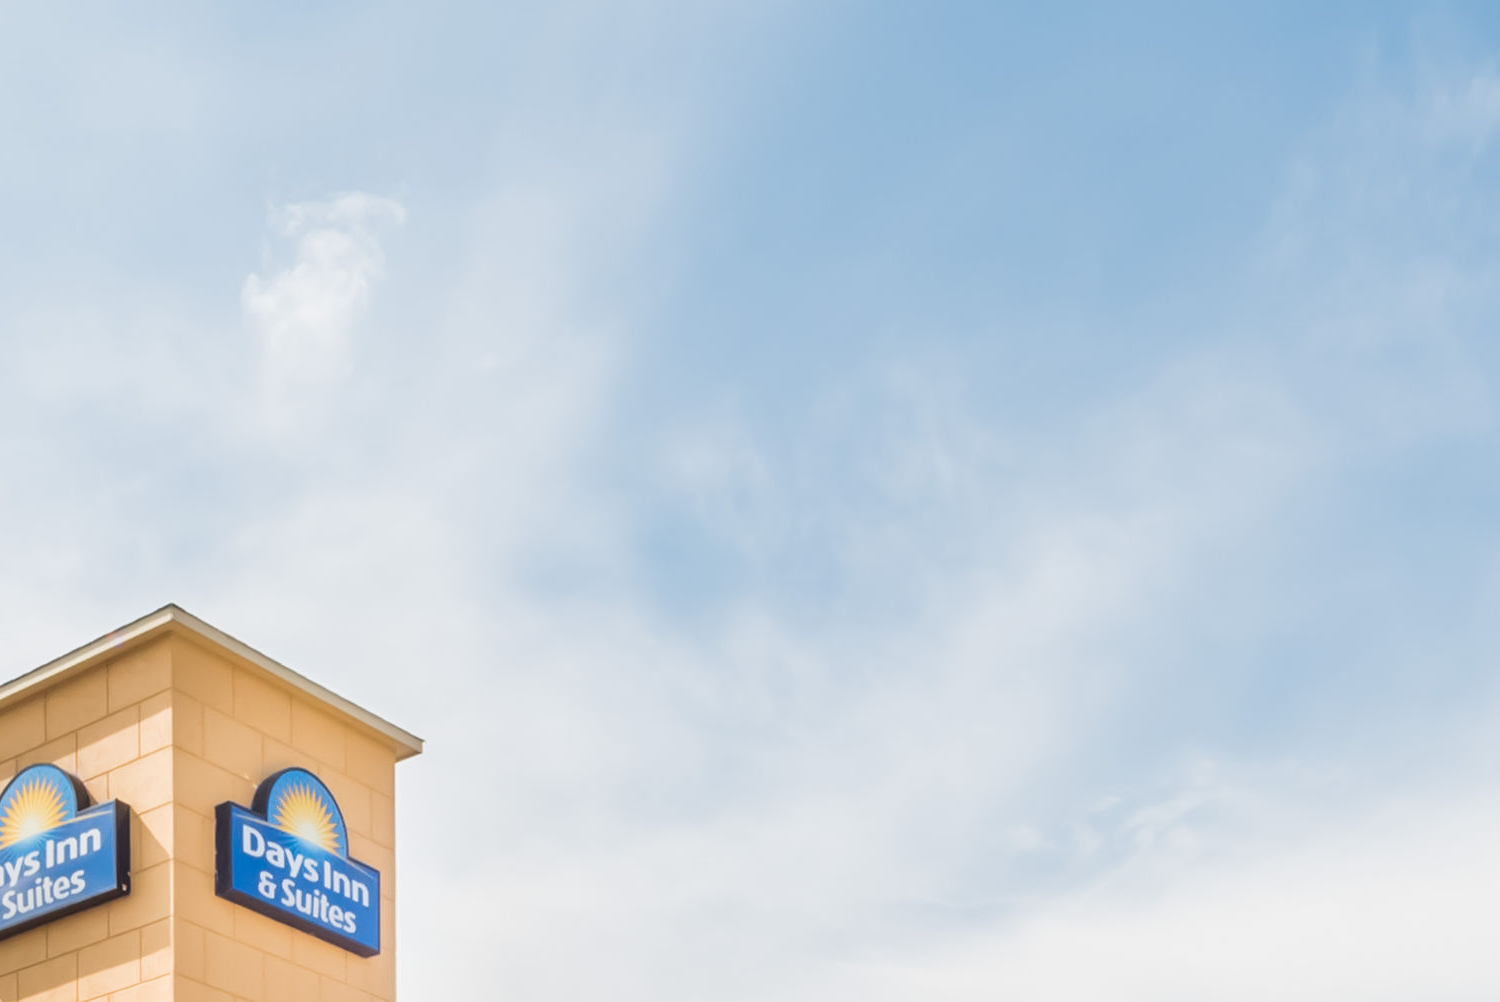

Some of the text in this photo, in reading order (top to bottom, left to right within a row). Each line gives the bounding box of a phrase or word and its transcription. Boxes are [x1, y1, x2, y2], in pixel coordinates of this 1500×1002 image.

[45, 828, 101, 869] Inn
[242, 824, 369, 908] Days Inn
[2, 870, 86, 920] Suites
[258, 871, 357, 934] & Suites
